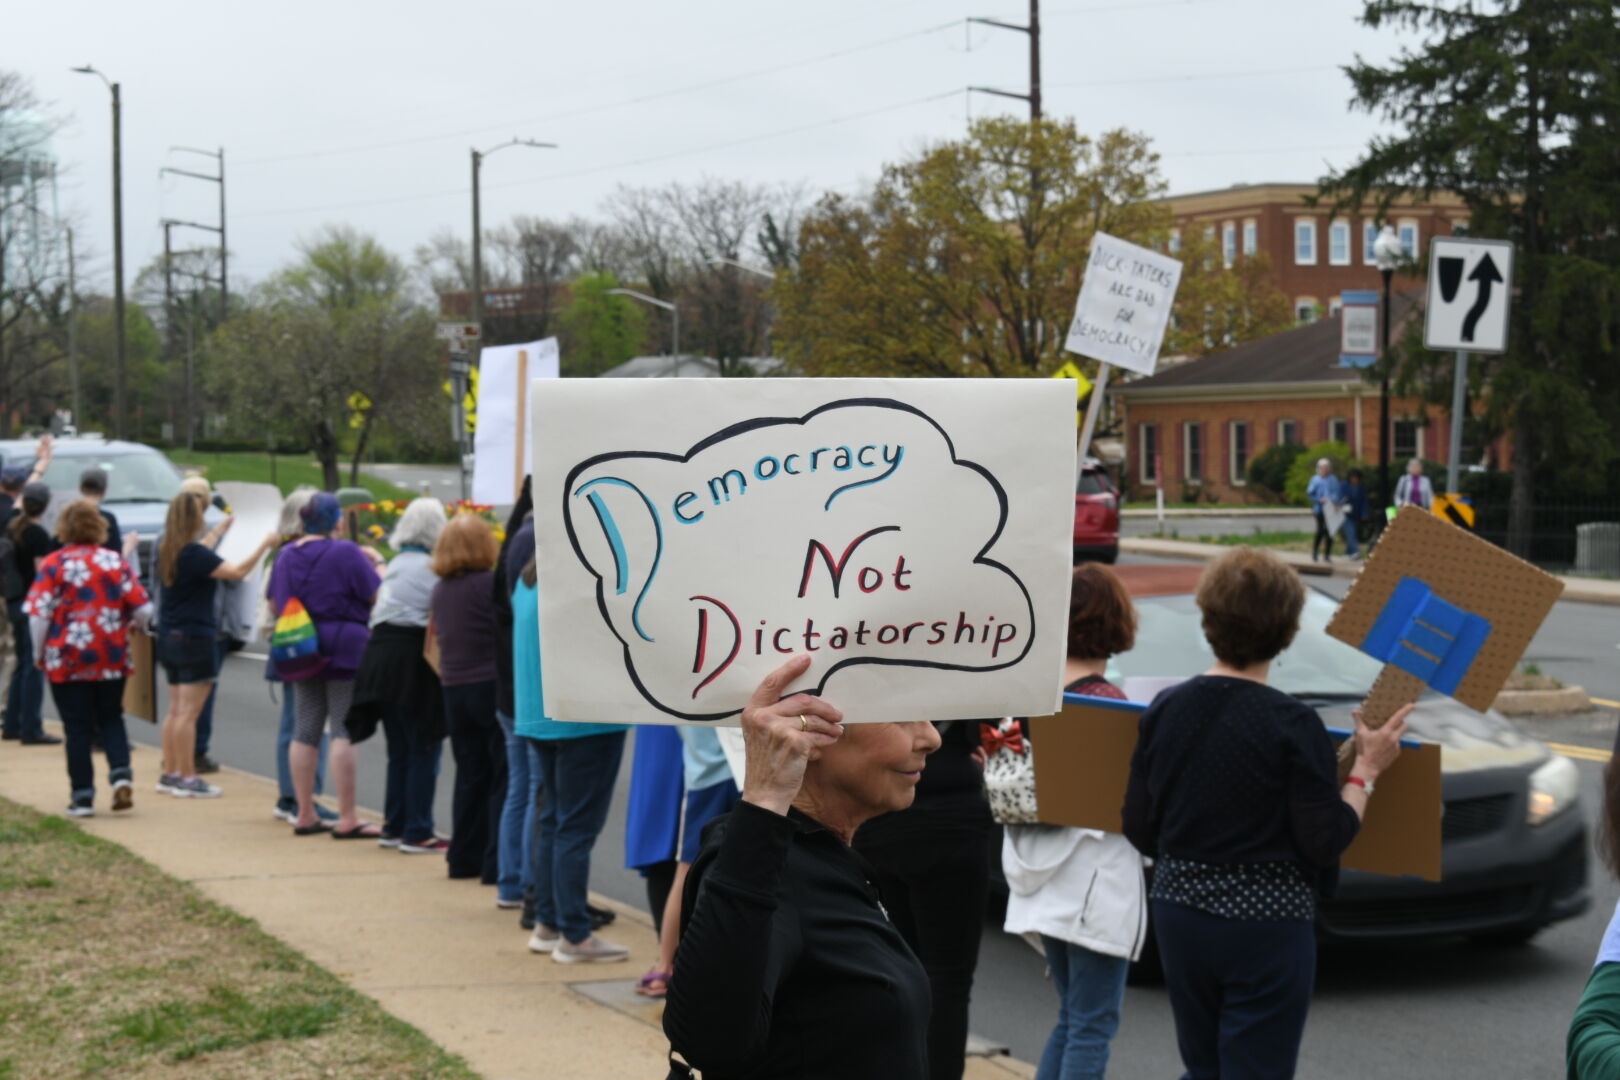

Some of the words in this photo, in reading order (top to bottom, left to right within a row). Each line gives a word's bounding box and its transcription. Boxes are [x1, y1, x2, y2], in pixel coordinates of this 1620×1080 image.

[1107, 280, 1134, 299] ARE
[1135, 288, 1156, 307] BAD
[574, 442, 905, 643] Democracy
[797, 525, 912, 599] Not
[689, 595, 1018, 700] Dictatorship
